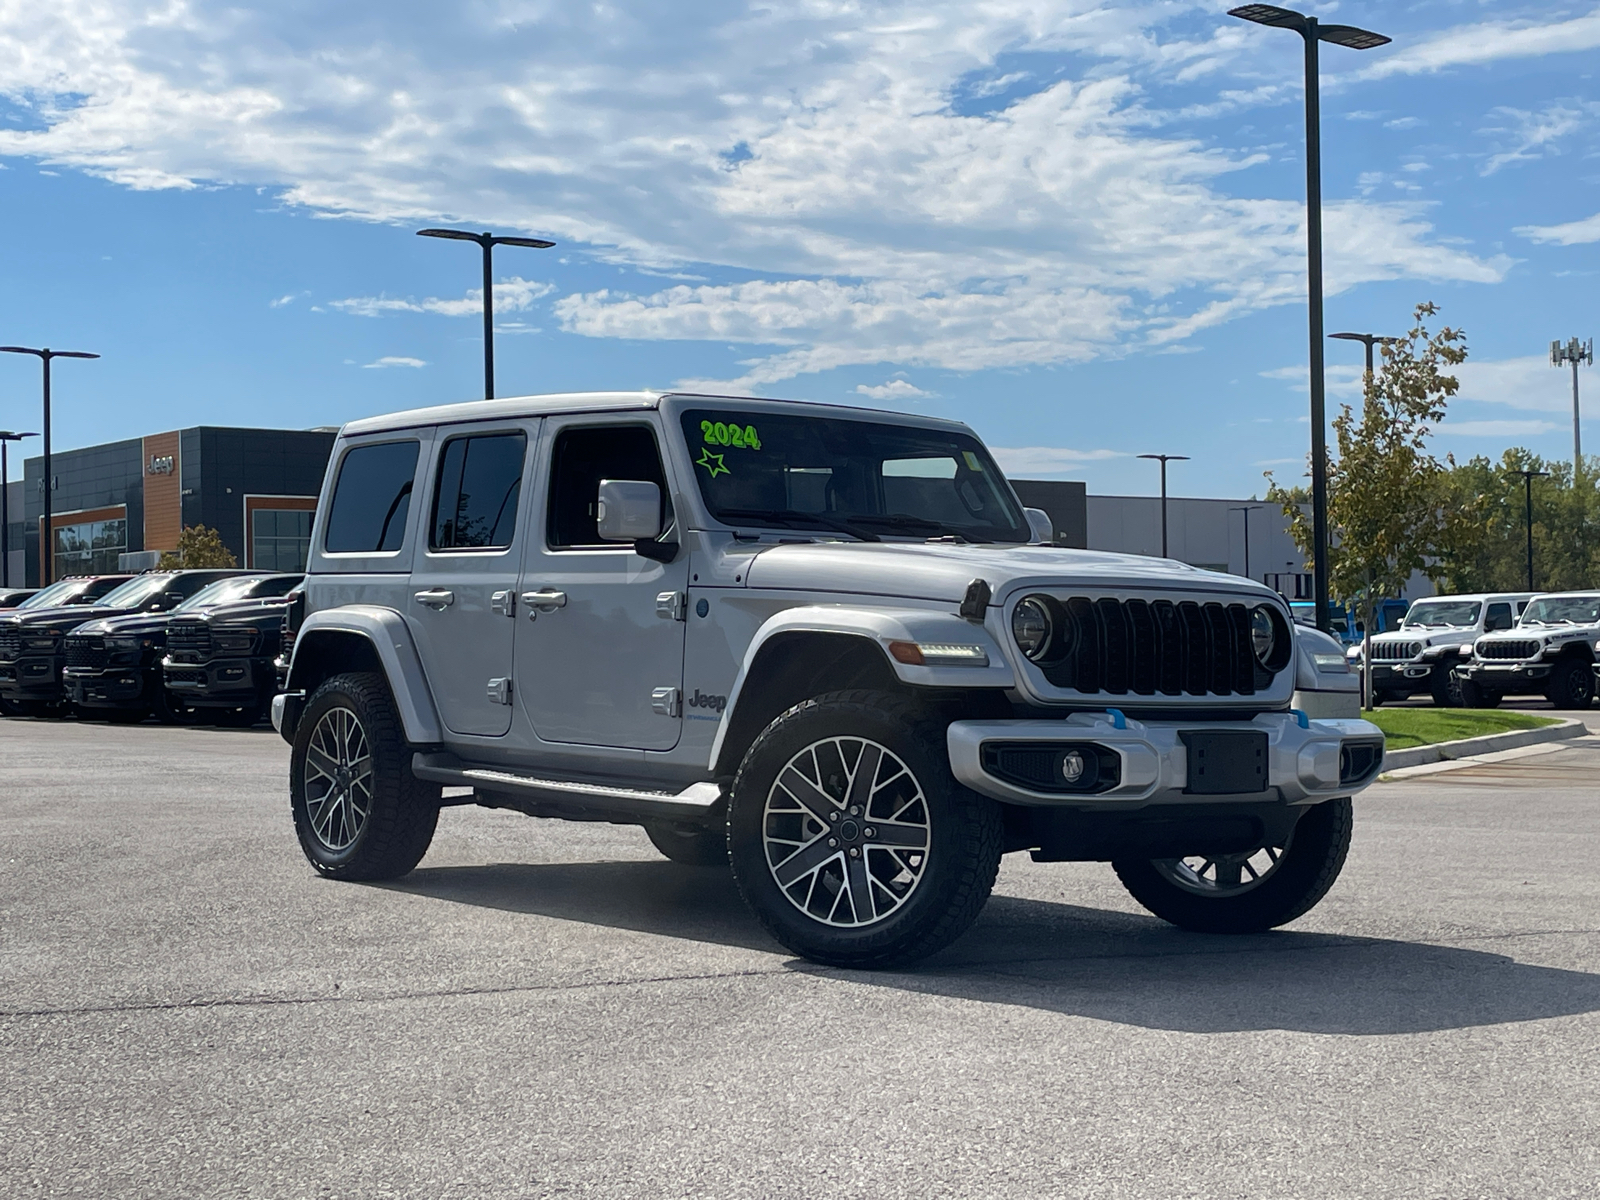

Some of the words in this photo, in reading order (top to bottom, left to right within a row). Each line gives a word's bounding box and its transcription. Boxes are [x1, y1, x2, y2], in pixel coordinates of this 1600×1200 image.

[700, 420, 762, 450] 2024
[146, 454, 175, 476] Jeep
[688, 688, 727, 713] Jeep
